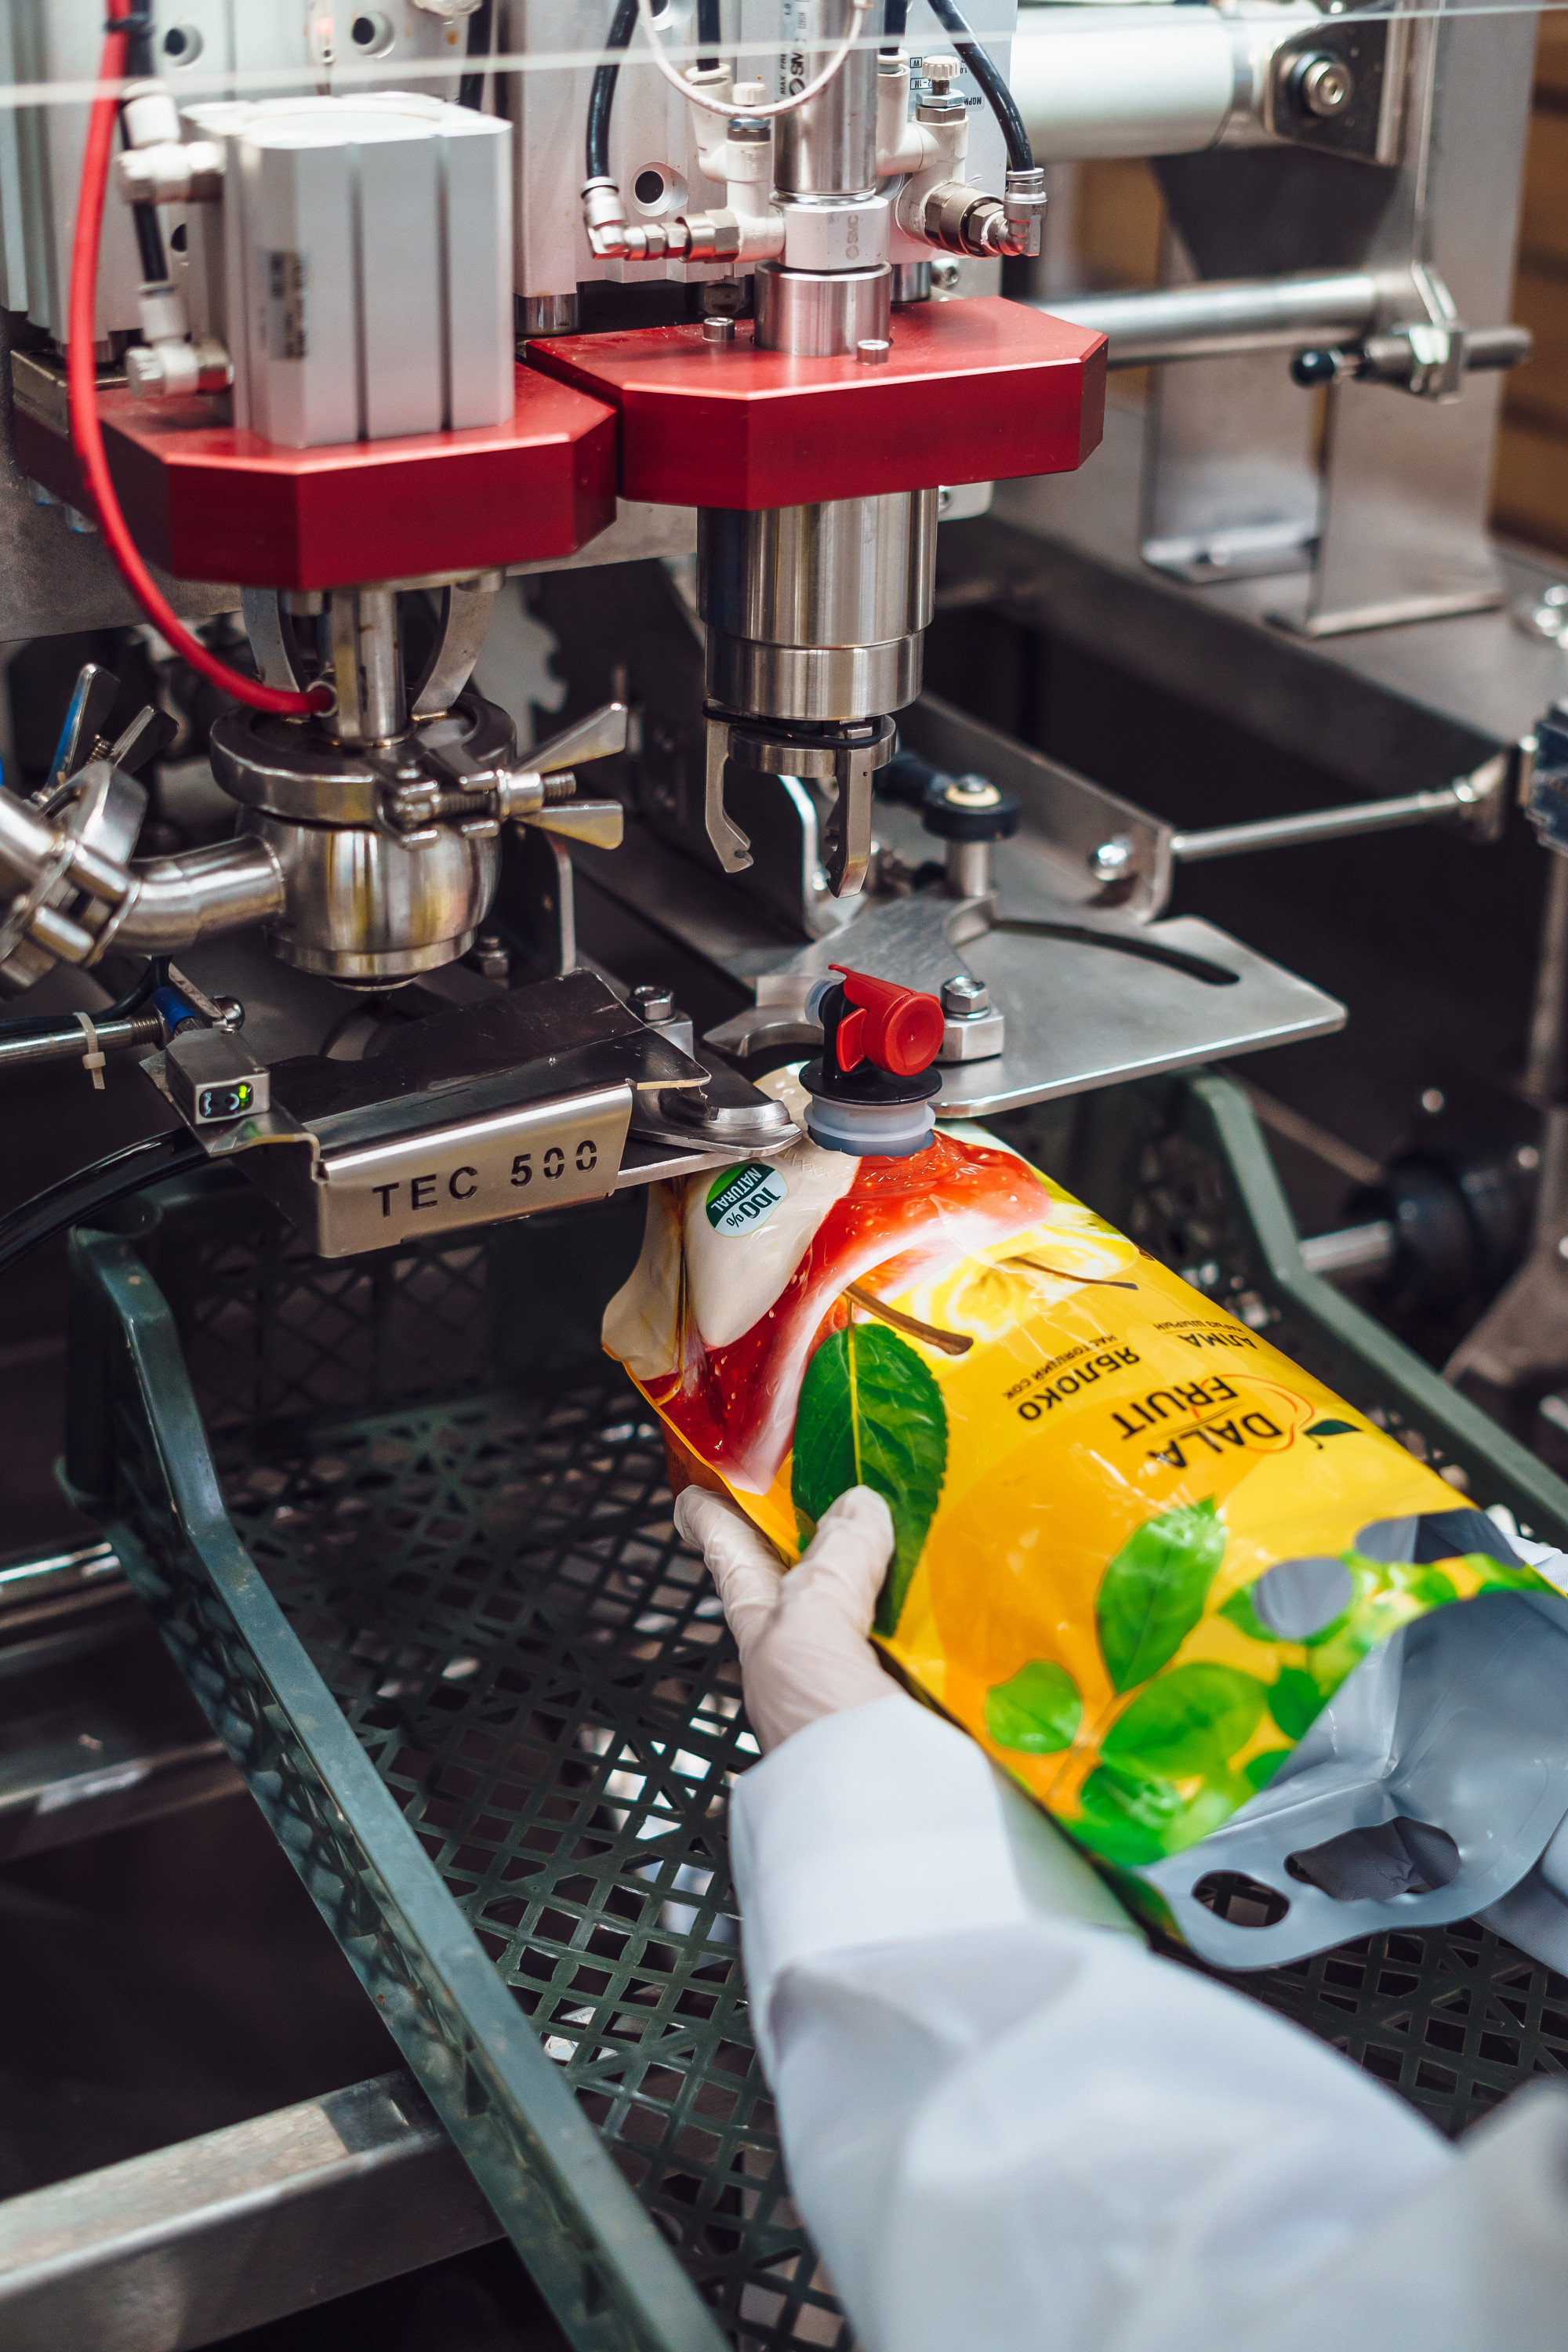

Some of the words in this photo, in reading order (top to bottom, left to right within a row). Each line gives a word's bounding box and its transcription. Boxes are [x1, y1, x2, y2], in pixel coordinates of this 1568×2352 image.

[847, 215, 858, 245] SMC
[372, 1165, 478, 1218] TEC
[510, 1139, 598, 1188] 500
[710, 1167, 762, 1212] NATURAL
[725, 1186, 782, 1229] 100%
[1176, 1332, 1258, 1350] АЛМА
[1002, 1378, 1033, 1400] СОК
[1018, 1347, 1140, 1421] ЯБЛОКО
[1110, 1376, 1238, 1441] FRUIT
[1146, 1412, 1283, 1470] DALA
